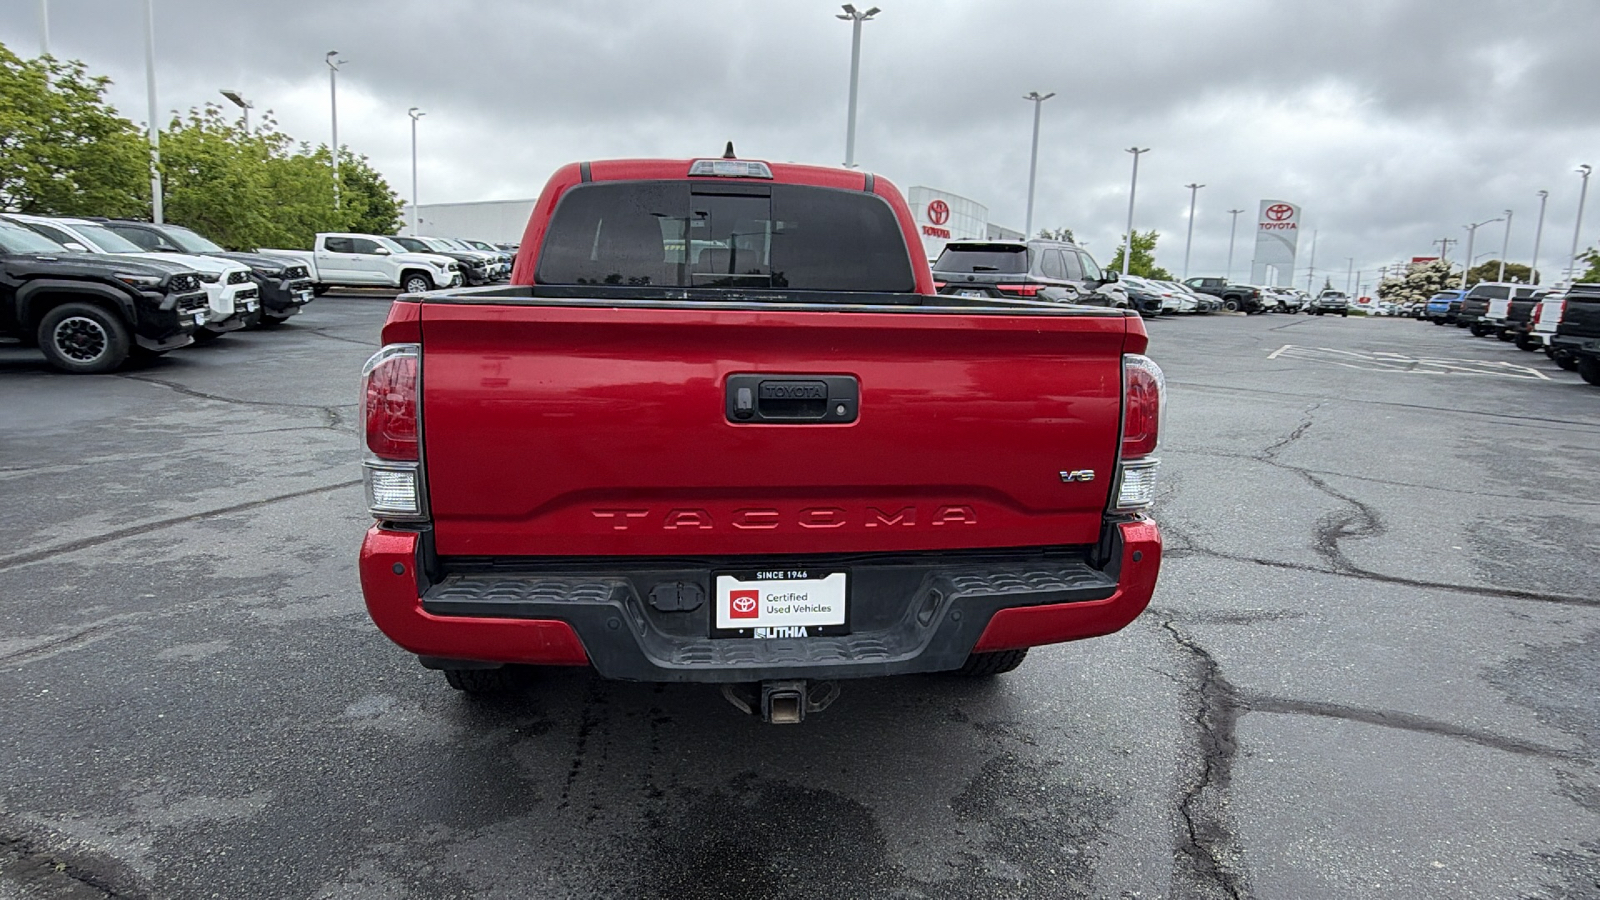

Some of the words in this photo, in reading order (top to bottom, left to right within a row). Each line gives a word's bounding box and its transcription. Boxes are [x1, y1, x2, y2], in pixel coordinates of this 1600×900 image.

[922, 225, 951, 239] TOYOTA
[1259, 222, 1297, 230] TOYOTA
[766, 385, 822, 398] TOYOTA
[1059, 469, 1095, 482] V6
[591, 505, 977, 530] TACOMA
[756, 571, 784, 580] SINCE
[787, 571, 808, 579] 1946
[766, 592, 808, 602] Certified
[766, 605, 791, 614] Used
[793, 604, 832, 613] Vehicles
[766, 626, 808, 638] LITHIA
